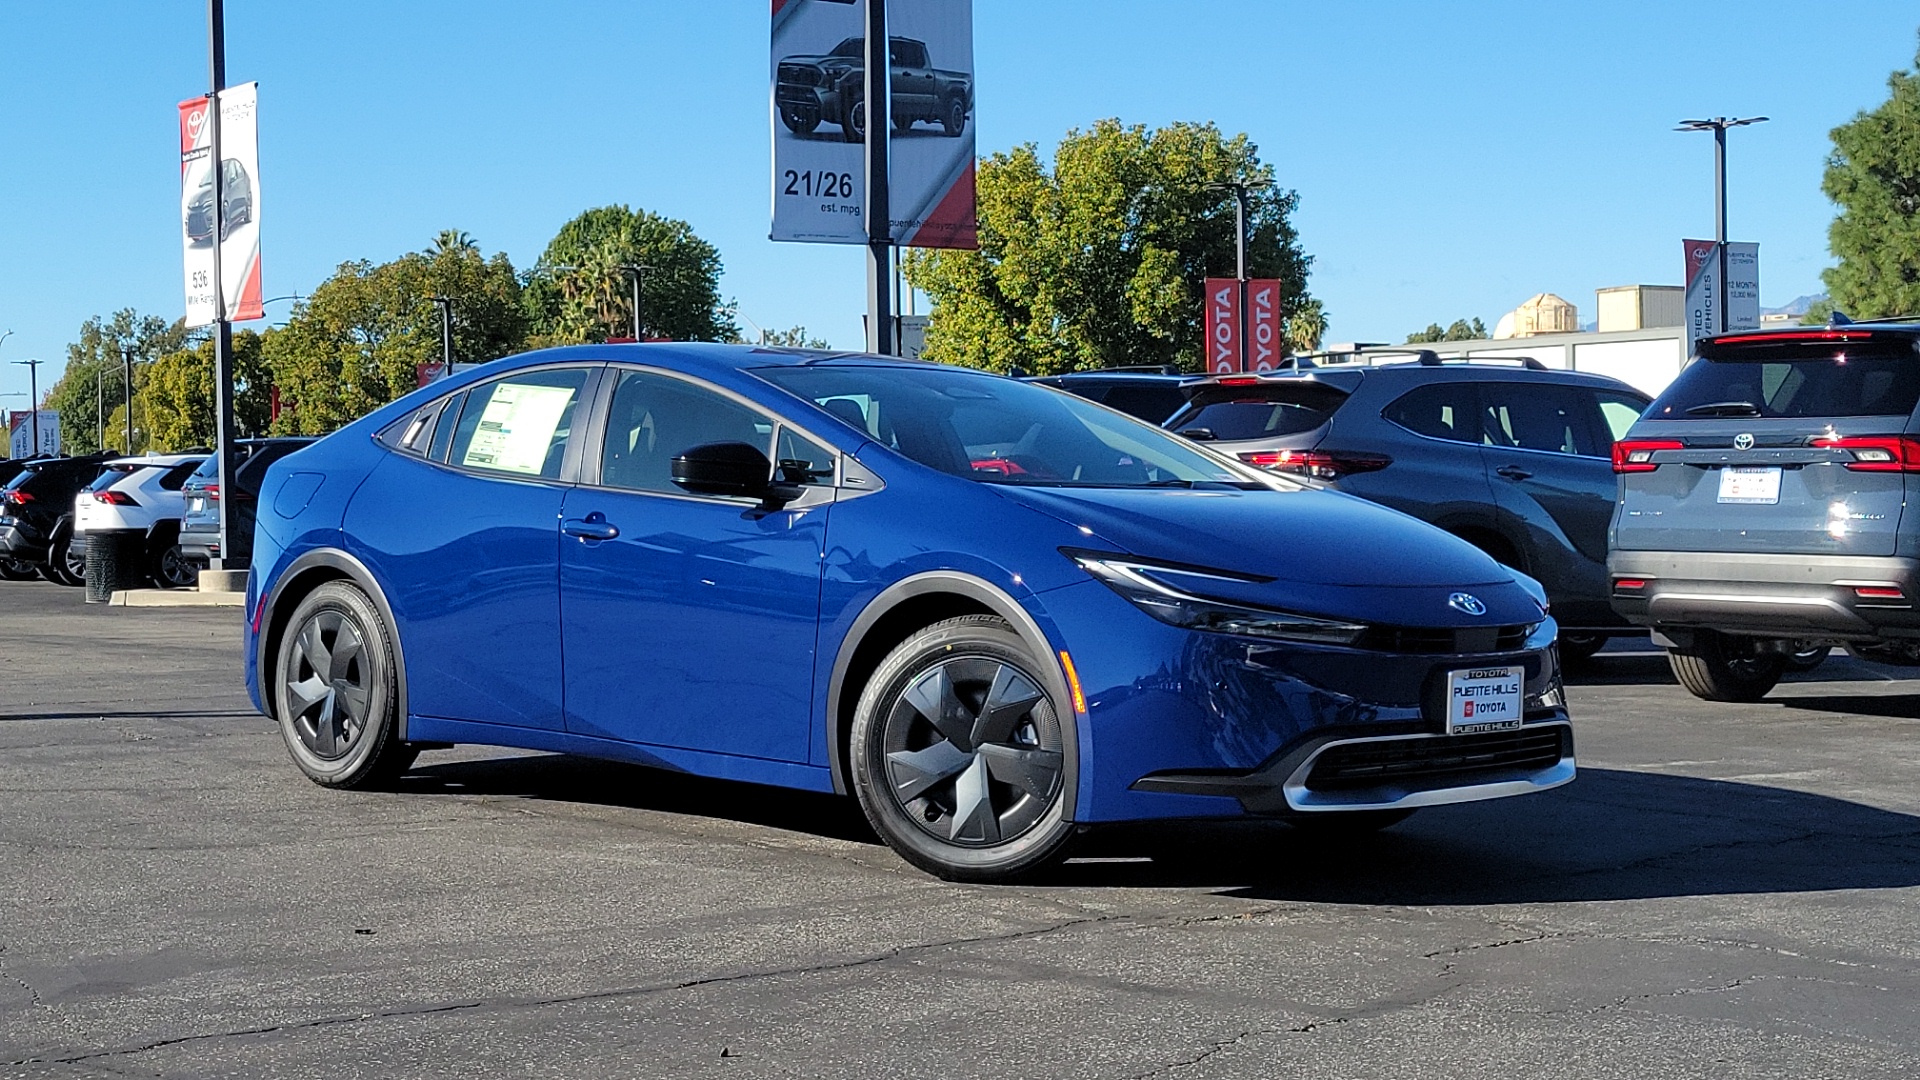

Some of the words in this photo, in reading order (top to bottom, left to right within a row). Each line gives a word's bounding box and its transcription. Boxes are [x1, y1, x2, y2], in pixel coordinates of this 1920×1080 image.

[785, 170, 852, 198] 21/26
[821, 203, 838, 213] est.
[841, 205, 860, 216] mpg
[193, 270, 209, 289] 536
[1470, 670, 1508, 678] TOYOTA
[1454, 685, 1491, 697] PUENTE
[1493, 684, 1518, 695] HILLS
[1476, 702, 1506, 713] TOYOTA
[1454, 723, 1492, 733] PUENTE
[1492, 720, 1519, 730] HILLS
